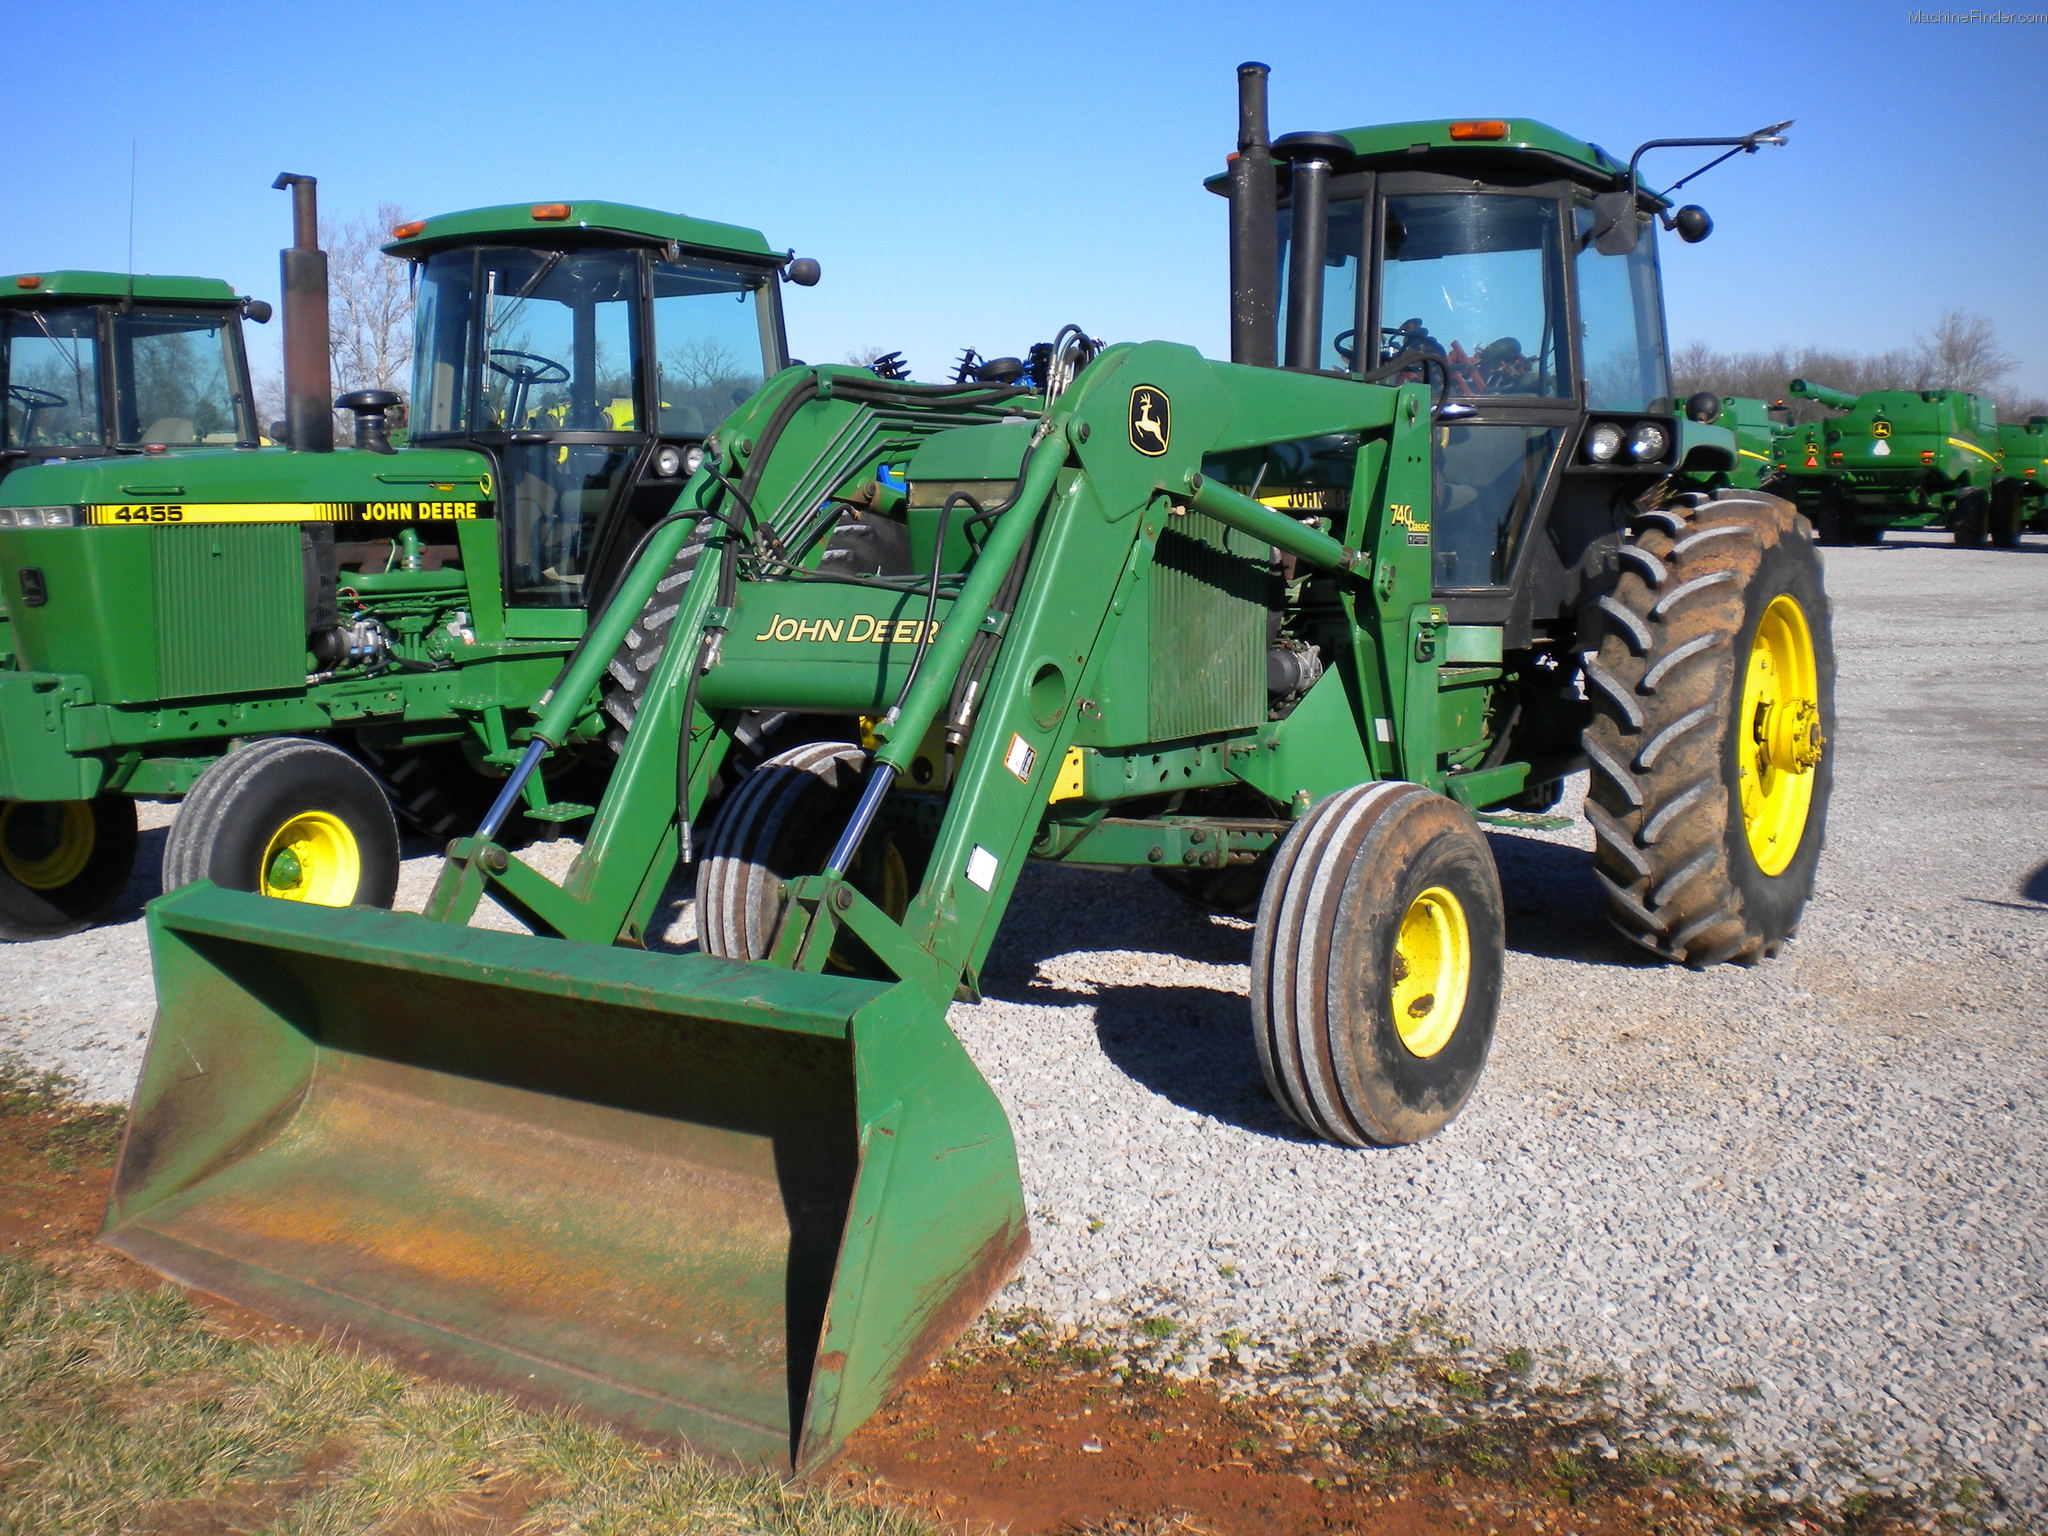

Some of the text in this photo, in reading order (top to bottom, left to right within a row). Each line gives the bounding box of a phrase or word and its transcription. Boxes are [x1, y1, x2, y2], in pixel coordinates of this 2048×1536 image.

[1287, 489, 1325, 509] JOHN
[115, 505, 184, 523] 4455
[361, 502, 477, 521] JOHN DEERE
[1390, 504, 1413, 526] 740
[1408, 520, 1430, 532] Classic
[755, 613, 945, 644] JOHN DEER
